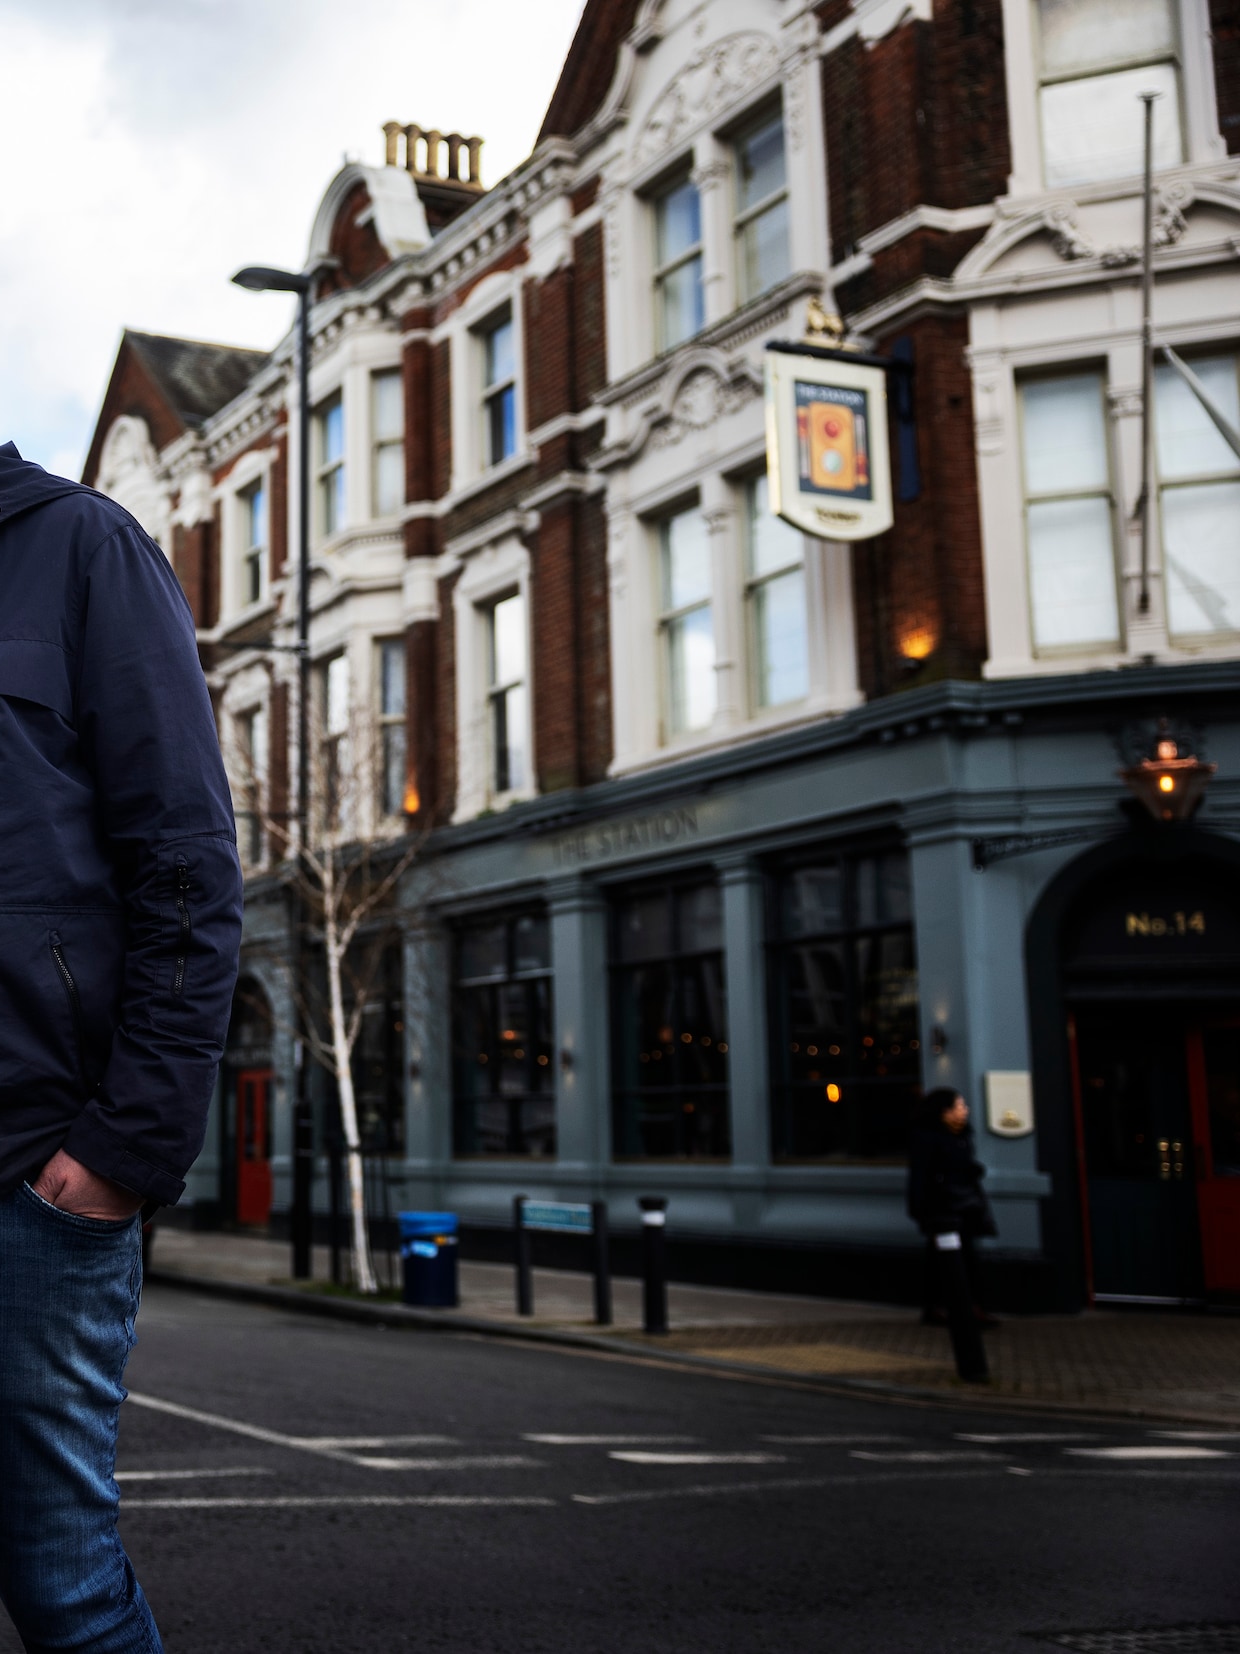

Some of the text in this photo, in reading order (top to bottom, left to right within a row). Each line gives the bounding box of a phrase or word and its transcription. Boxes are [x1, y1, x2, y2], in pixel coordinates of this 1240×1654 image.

[552, 806, 699, 865] THE STATION
[1126, 911, 1205, 936] No.14
